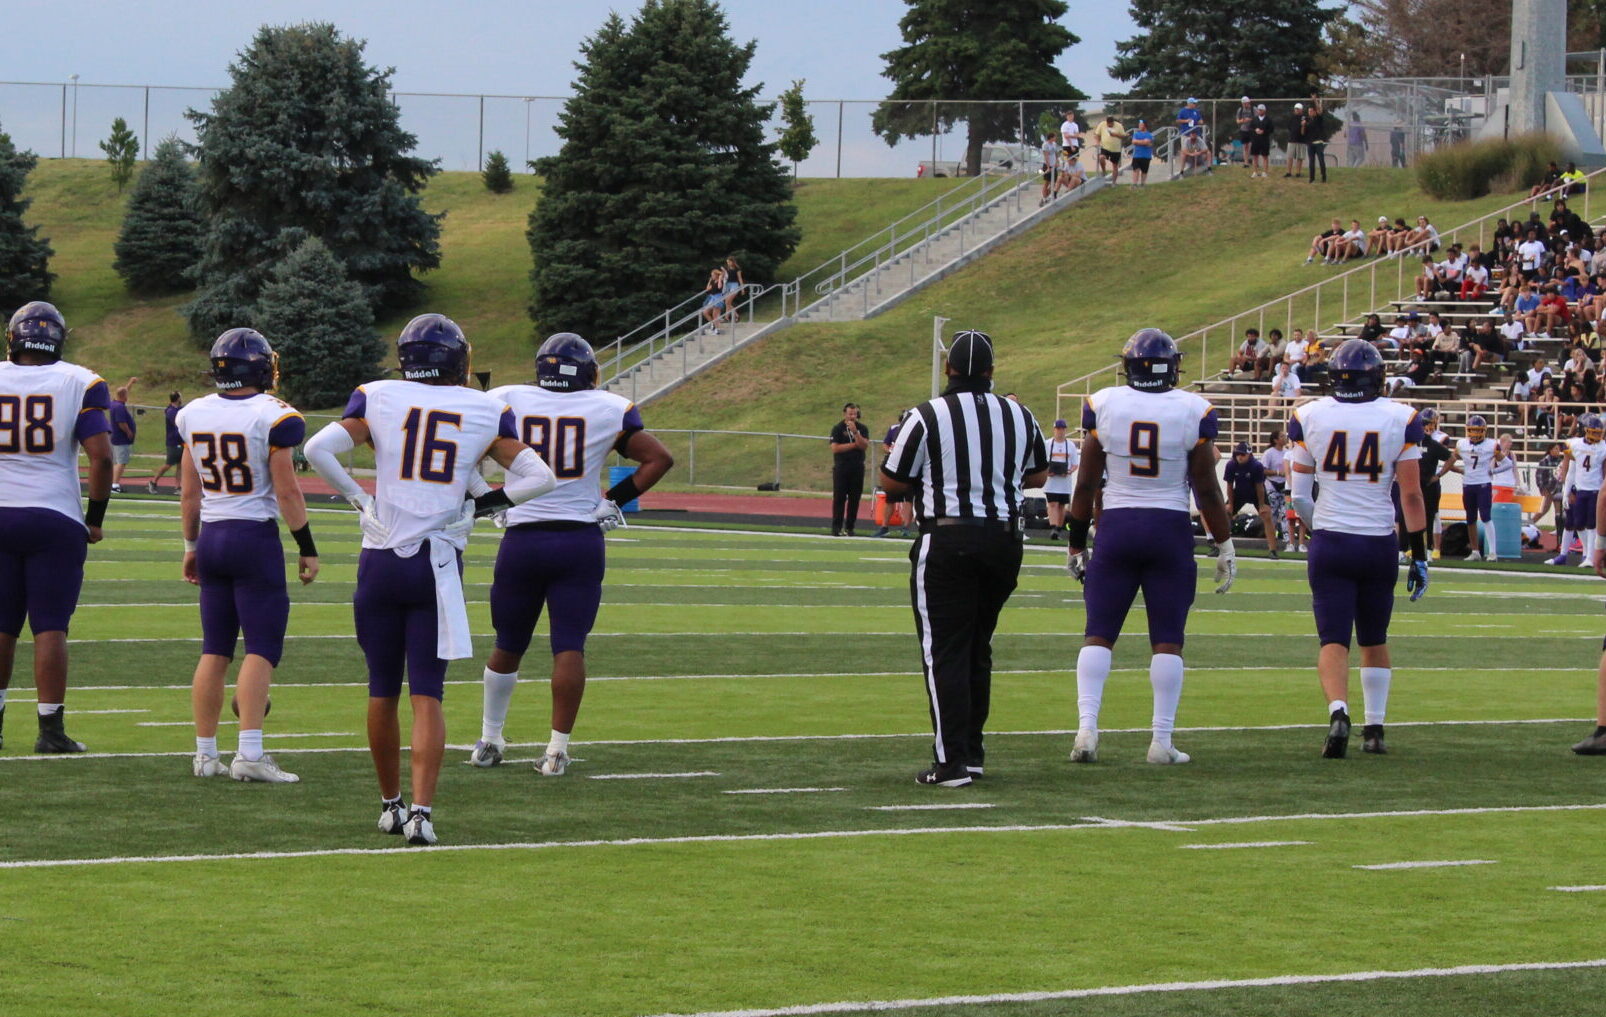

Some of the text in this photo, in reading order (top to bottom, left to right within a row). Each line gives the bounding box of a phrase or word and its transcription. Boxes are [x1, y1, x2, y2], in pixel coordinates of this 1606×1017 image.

[25, 341, 55, 352] Riddell
[405, 369, 439, 379] Riddell
[540, 379, 569, 387] Riddell
[1133, 379, 1163, 387] Riddell
[0, 394, 54, 455] 98
[400, 407, 462, 484] 16
[523, 415, 586, 480] 90
[1129, 421, 1160, 478] 9
[1323, 430, 1383, 484] 44
[1470, 455, 1479, 470] 7
[191, 432, 254, 495] 38
[1582, 455, 1591, 472] 4
